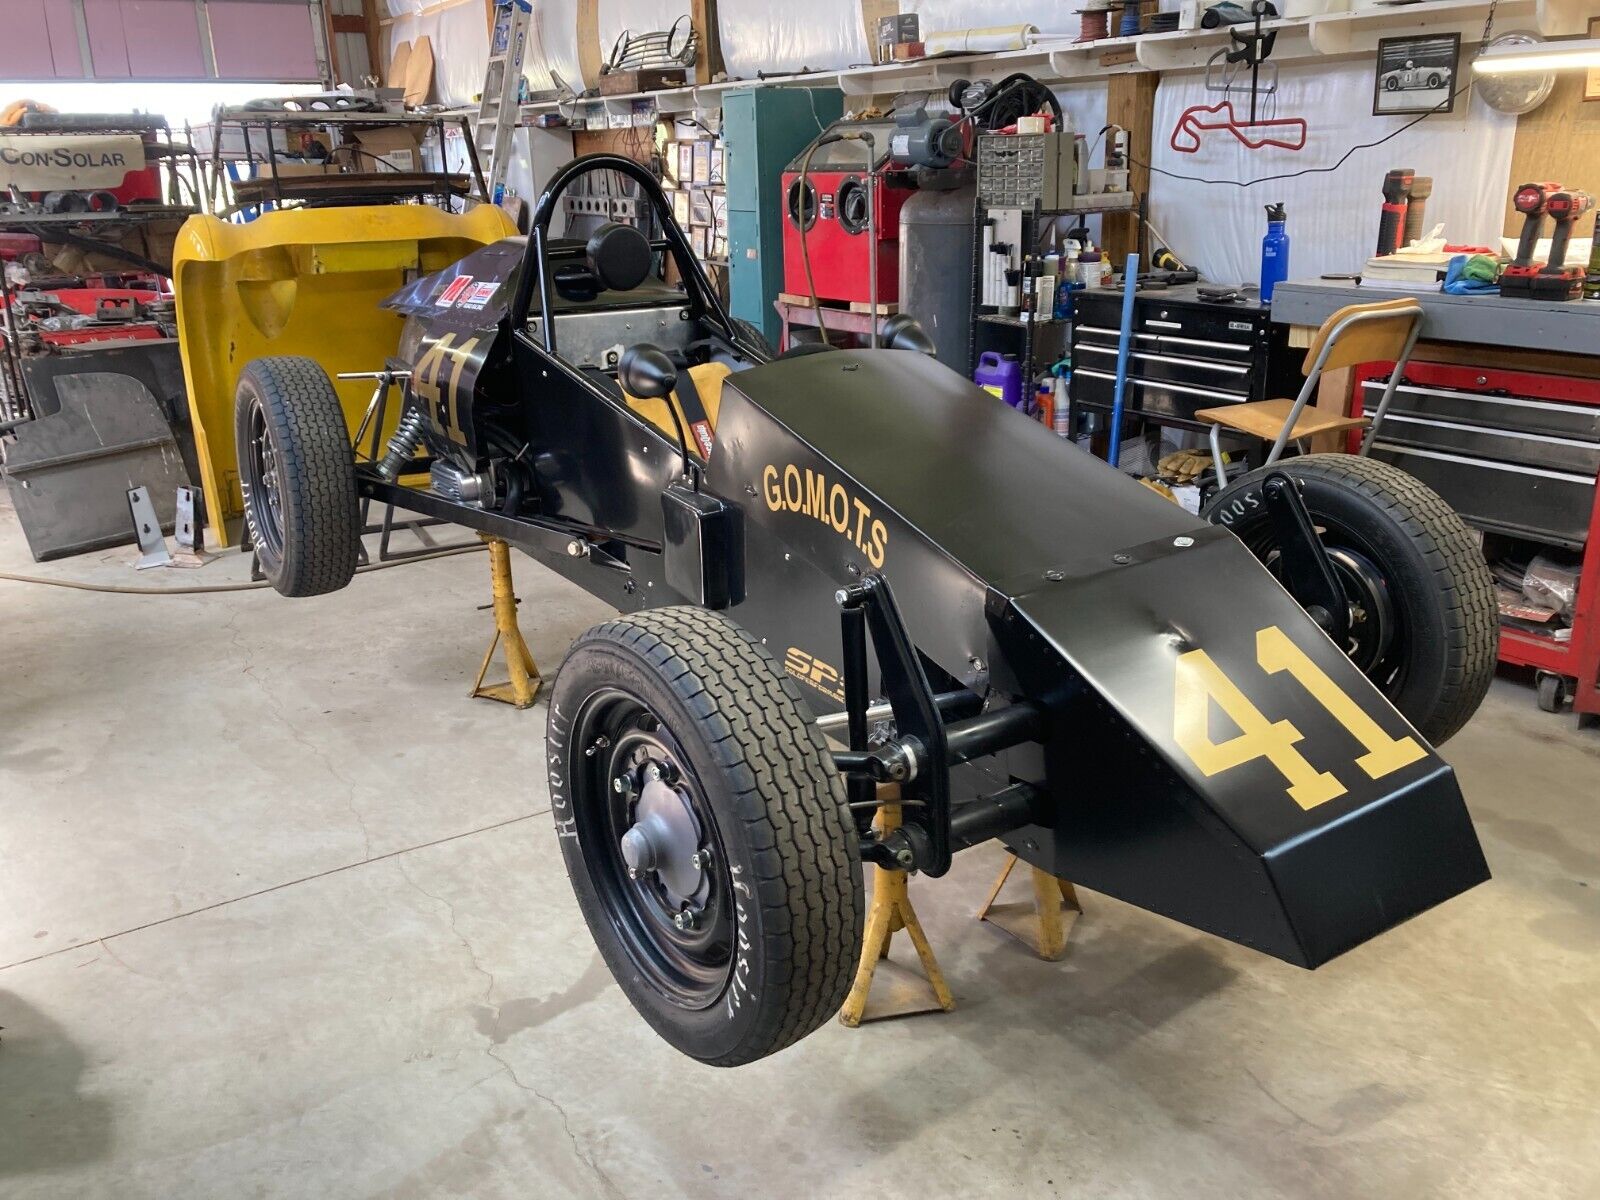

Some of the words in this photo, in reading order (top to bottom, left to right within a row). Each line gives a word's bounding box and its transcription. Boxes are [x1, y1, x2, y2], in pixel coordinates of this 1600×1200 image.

[412, 334, 479, 446] 41
[784, 646, 846, 697] SP
[1175, 626, 1428, 811] 41
